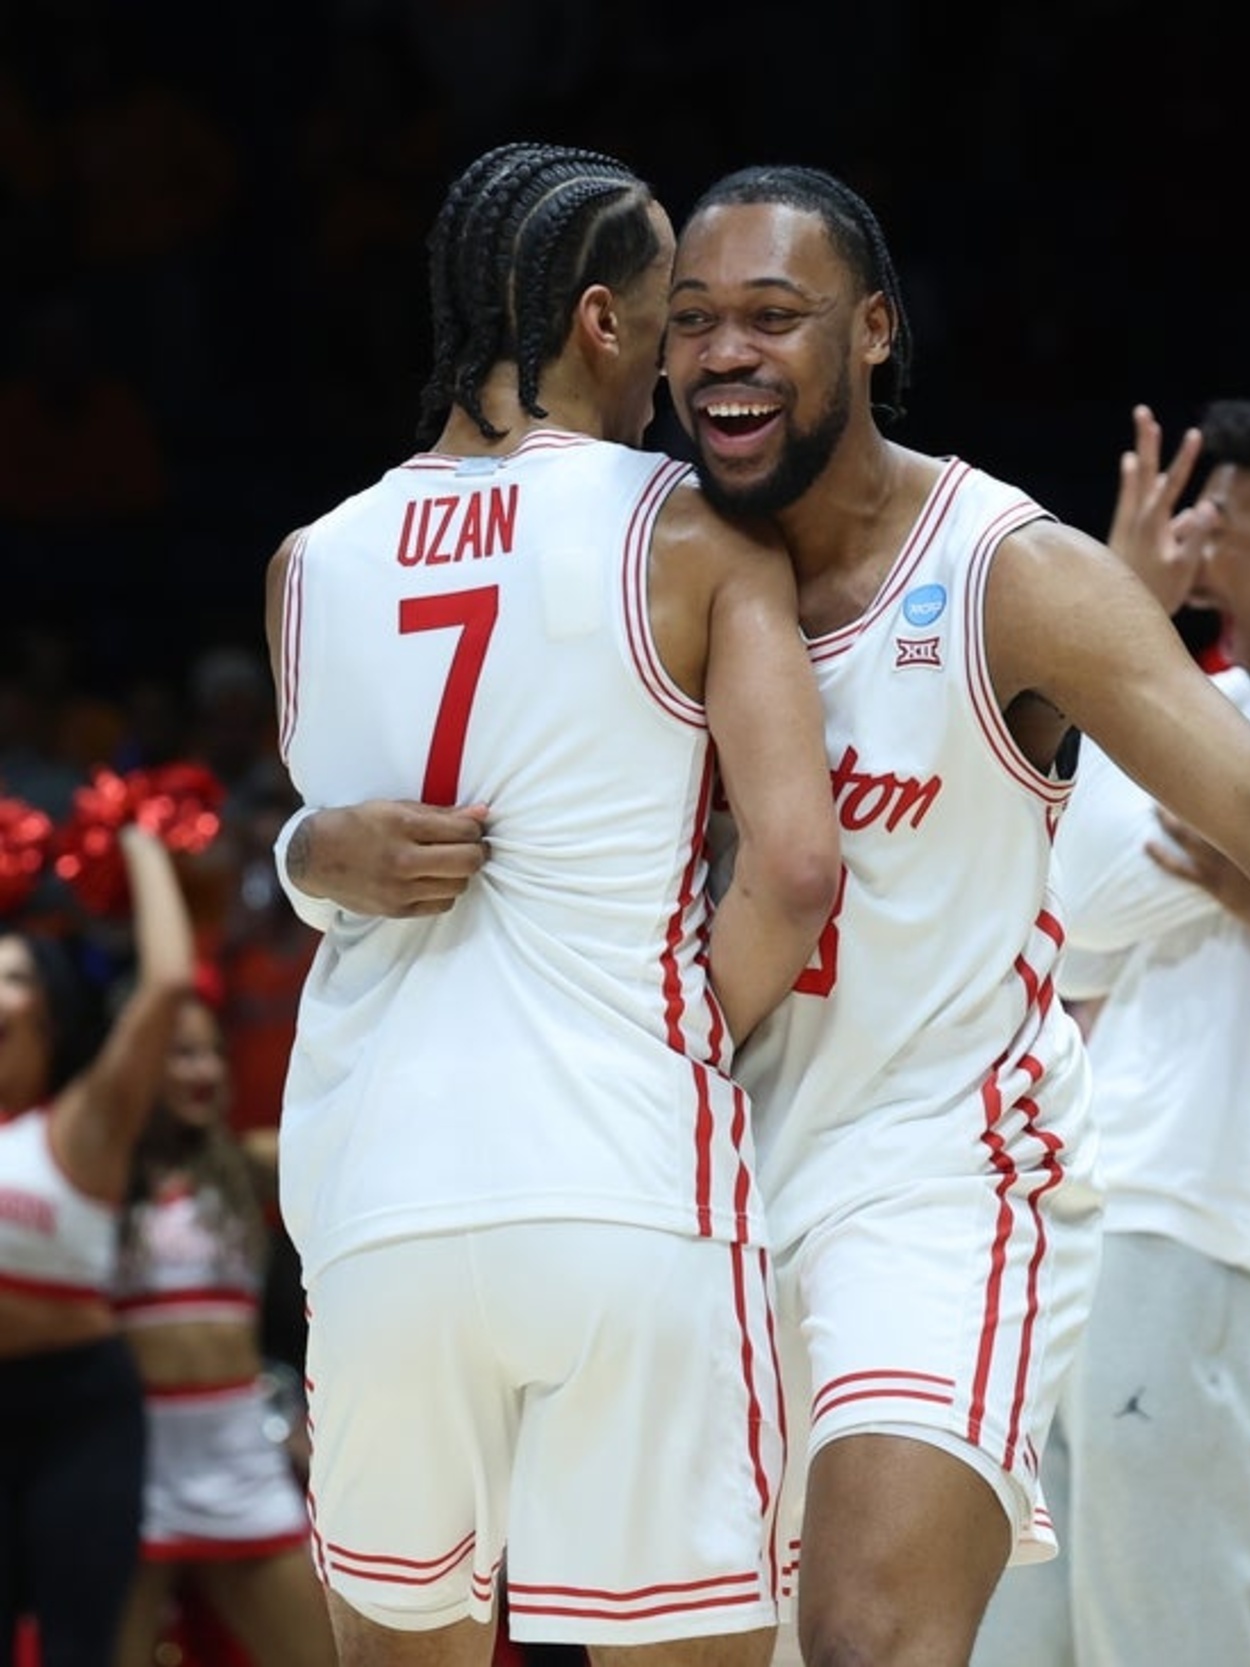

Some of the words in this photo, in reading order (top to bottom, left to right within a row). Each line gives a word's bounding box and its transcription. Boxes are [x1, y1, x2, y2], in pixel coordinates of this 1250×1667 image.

[397, 483, 520, 567] UZAN
[397, 584, 500, 807] 7
[829, 745, 943, 833] ton
